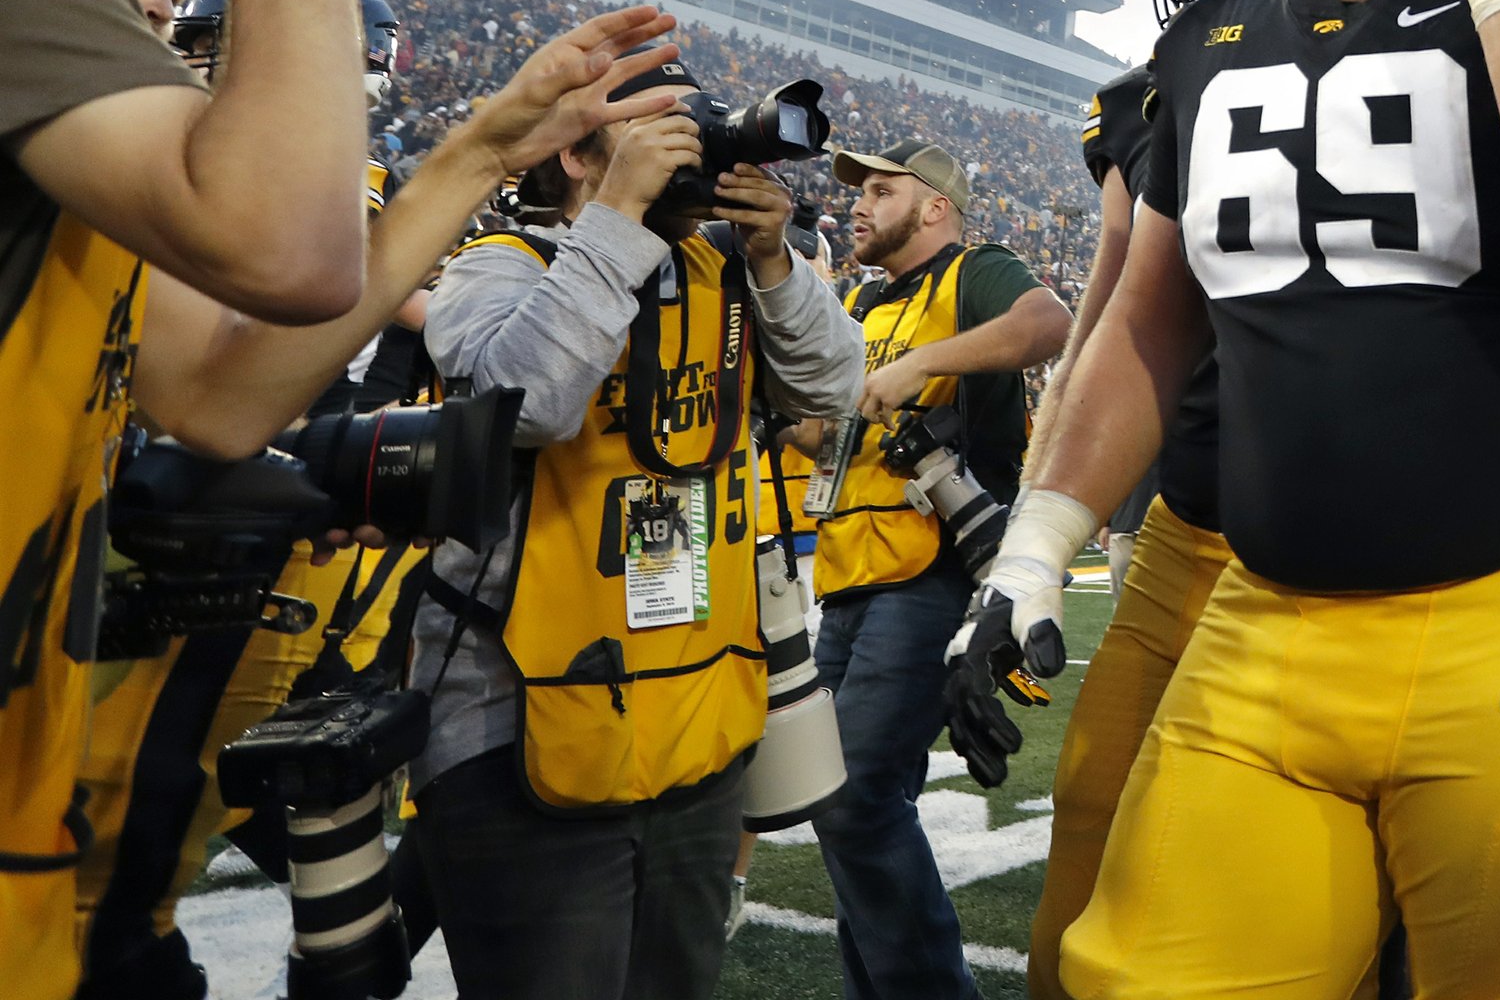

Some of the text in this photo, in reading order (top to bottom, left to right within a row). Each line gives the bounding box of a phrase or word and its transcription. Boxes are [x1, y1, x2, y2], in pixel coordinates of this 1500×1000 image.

[1182, 48, 1482, 300] 69
[723, 302, 742, 370] Canon
[703, 371, 718, 389] FO
[380, 444, 411, 453] Canon
[641, 519, 669, 543] 18
